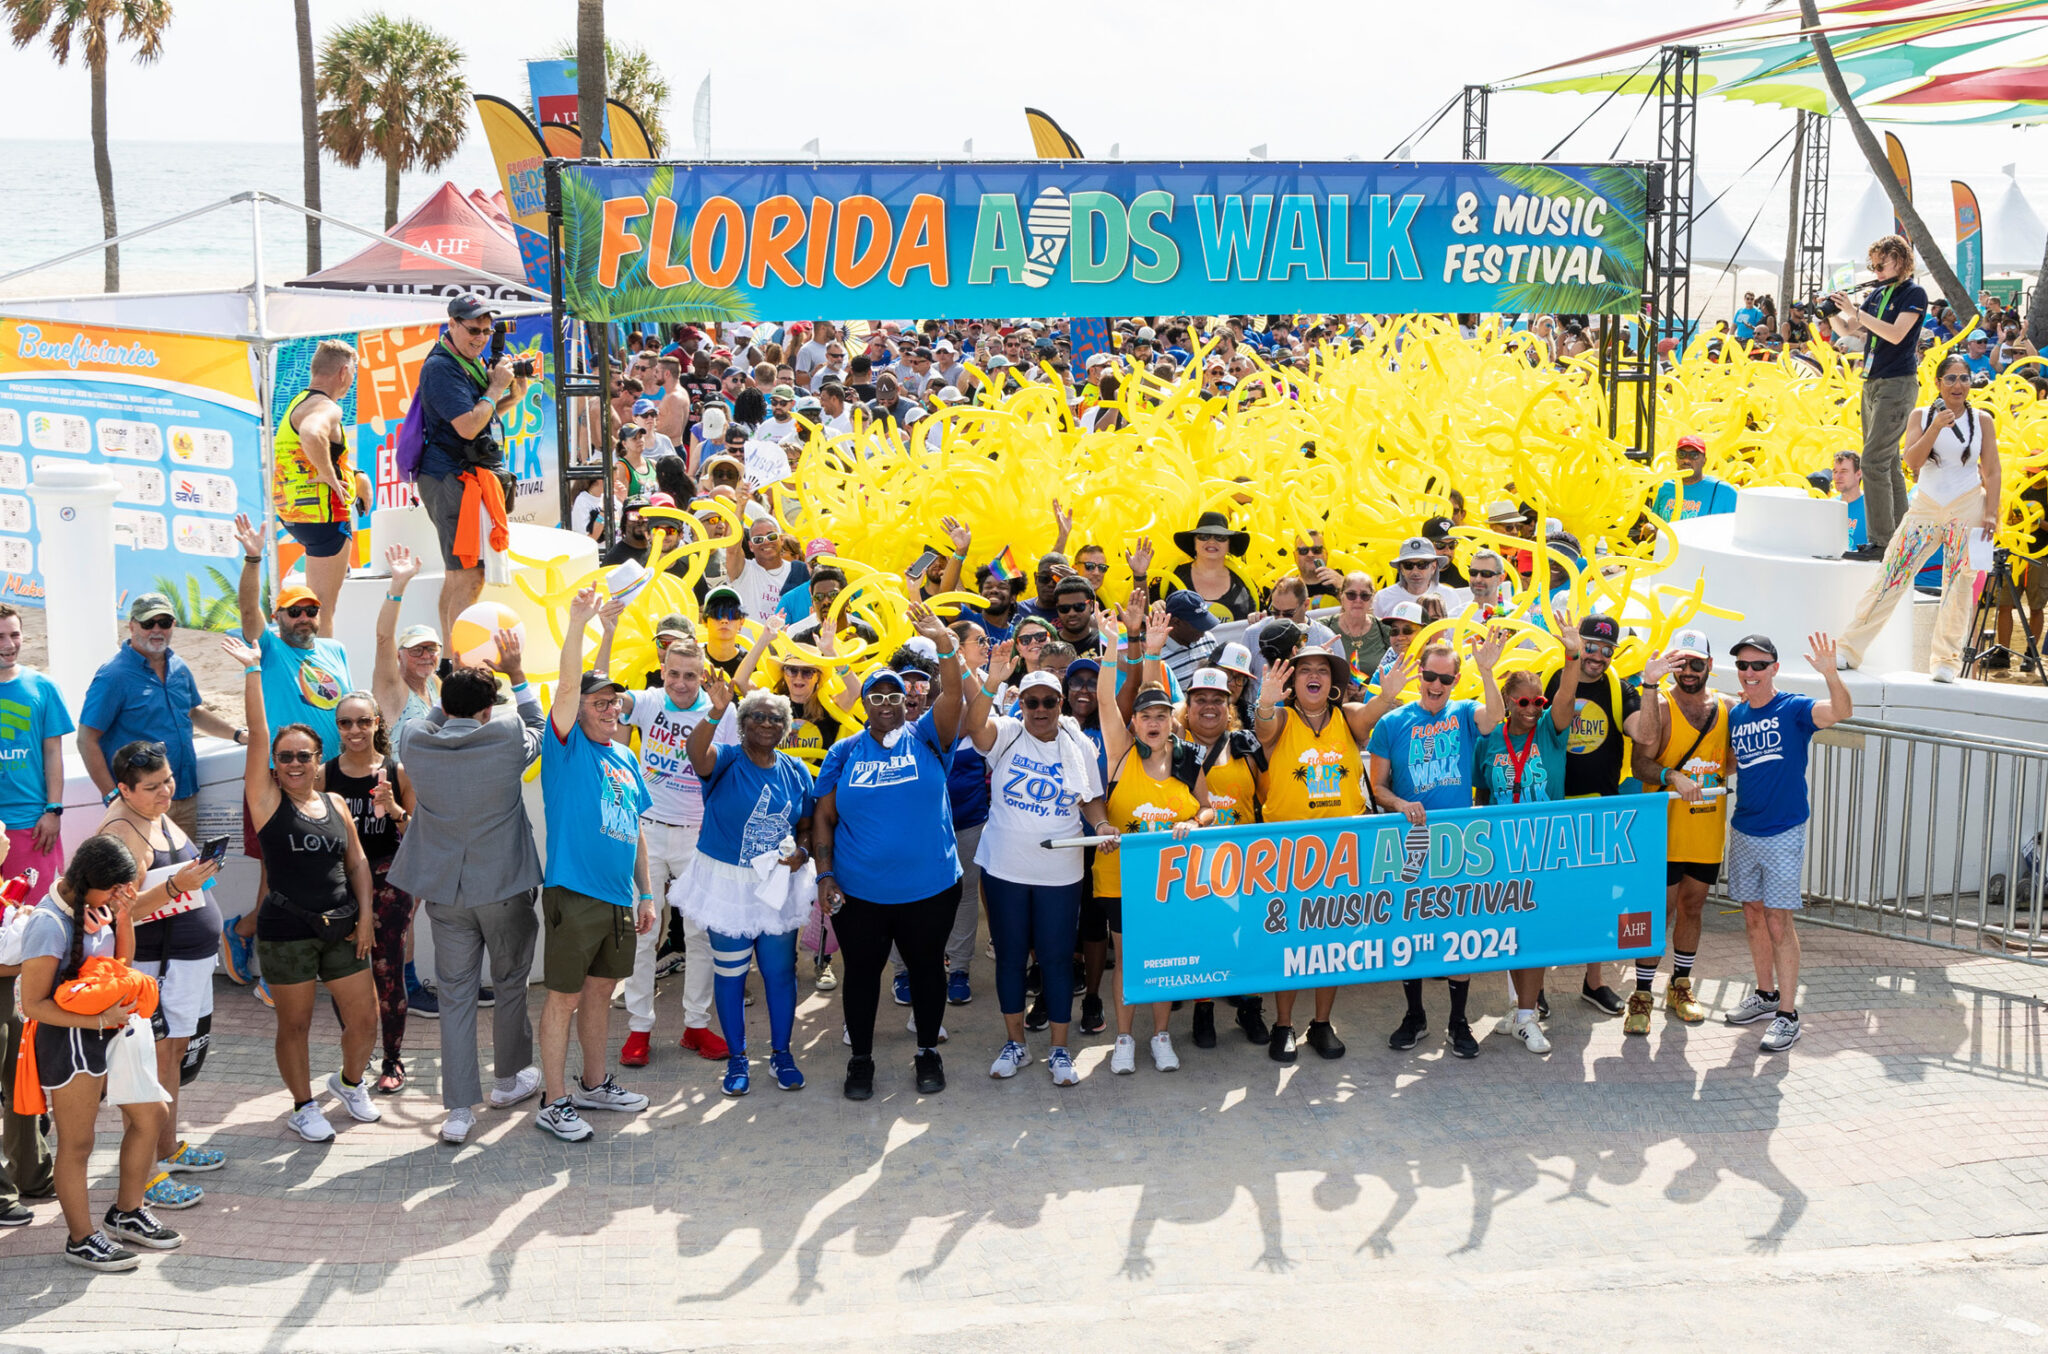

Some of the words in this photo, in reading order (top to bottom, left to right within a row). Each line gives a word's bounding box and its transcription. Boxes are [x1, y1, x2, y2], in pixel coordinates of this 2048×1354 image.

[1451, 191, 1480, 237] &
[1493, 191, 1608, 238] MUSIC
[414, 238, 470, 256] AHF
[597, 193, 950, 289] FLORIDA
[968, 186, 1181, 288] AIDS
[1193, 193, 1426, 282] WALK
[1443, 244, 1608, 285] FESTIVAL
[16, 323, 160, 369] Beneficiaries
[649, 724, 677, 747] LIVE
[671, 722, 694, 738] BO
[1732, 716, 1780, 738] LATINOS
[646, 738, 672, 756] STAY
[1731, 731, 1782, 755] SALUD
[645, 749, 679, 773] LOVE
[1408, 754, 1462, 787] WALK
[1306, 779, 1342, 795] WALK
[1141, 812, 1174, 821] FLORIDA
[1155, 831, 1360, 904] FLORIDA
[1369, 819, 1494, 884] AIDS
[1500, 809, 1638, 874] WALK
[1263, 896, 1288, 935] &
[1297, 889, 1393, 932] MUSIC
[1401, 877, 1538, 922] FESTIVAL
[1621, 921, 1648, 938] AHF
[1143, 956, 1188, 970] PRESENTED
[1188, 954, 1201, 966] BY
[1283, 938, 1384, 978] MARCH
[1391, 932, 1435, 967] 9TH
[1442, 927, 1518, 962] 2024
[1157, 970, 1230, 988] PHARMACY
